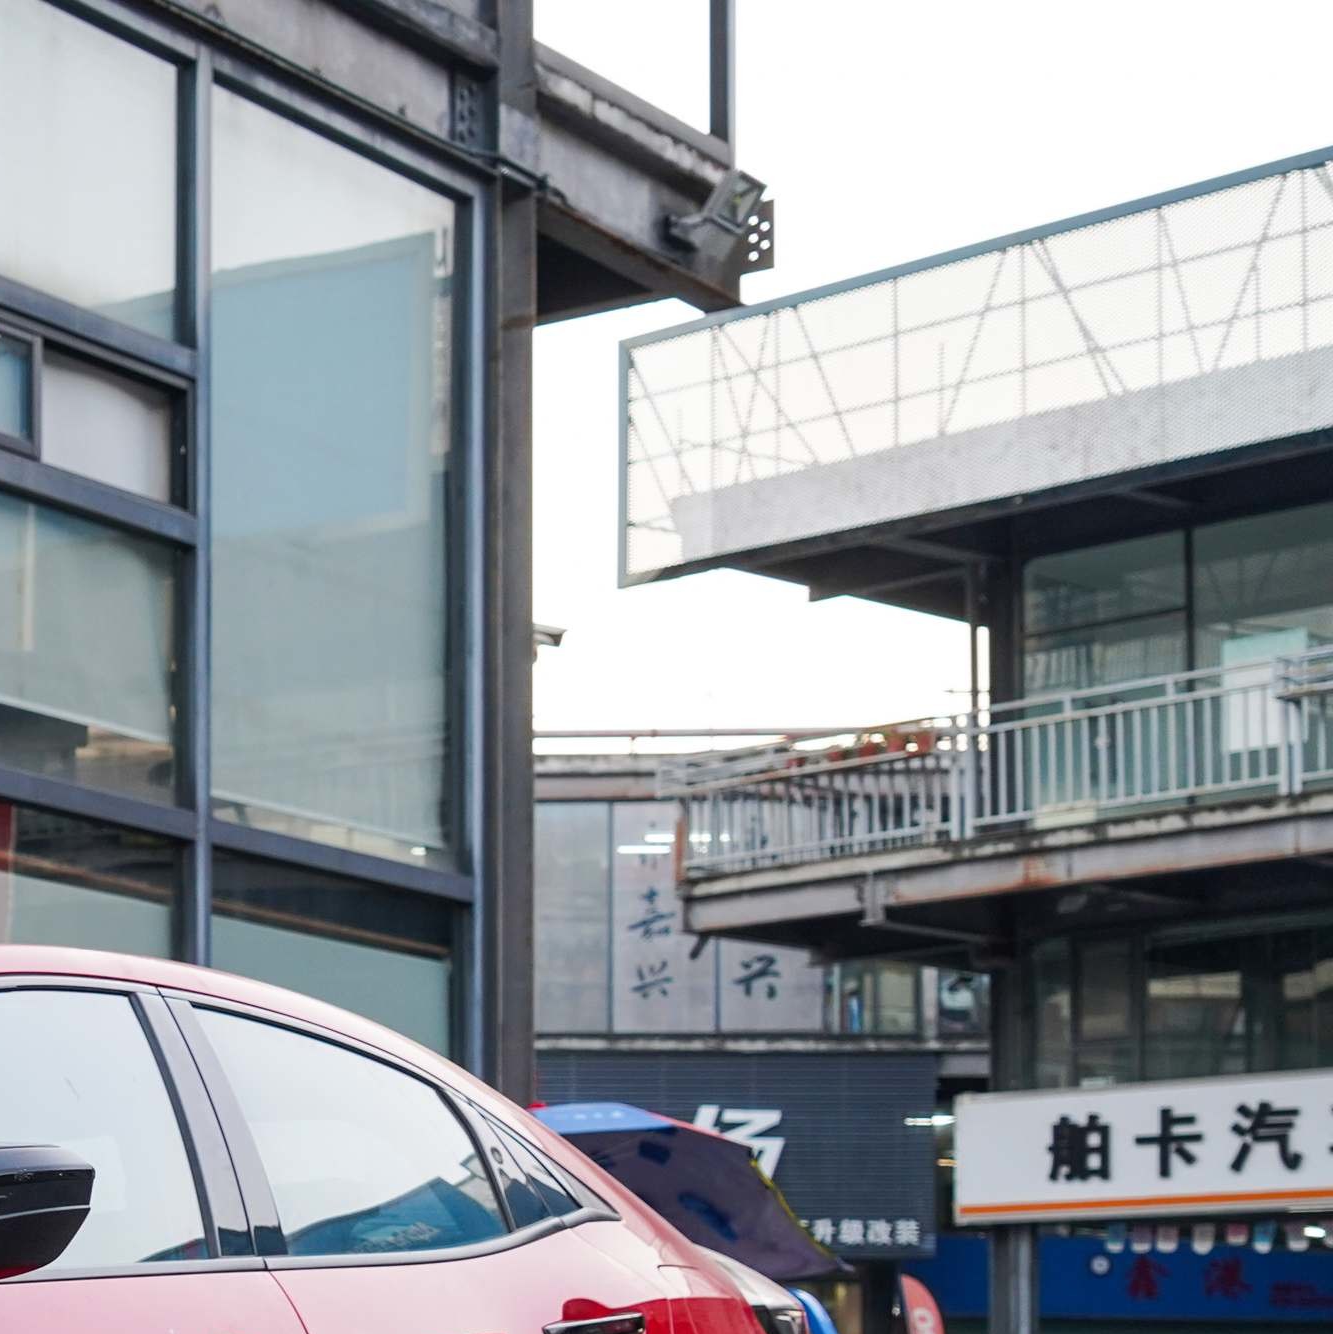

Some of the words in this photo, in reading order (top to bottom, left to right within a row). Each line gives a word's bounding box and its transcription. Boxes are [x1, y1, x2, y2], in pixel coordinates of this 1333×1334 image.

[1047, 1102, 1333, 1182] 舶卡汽
[799, 1218, 921, 1246] 升级改装
